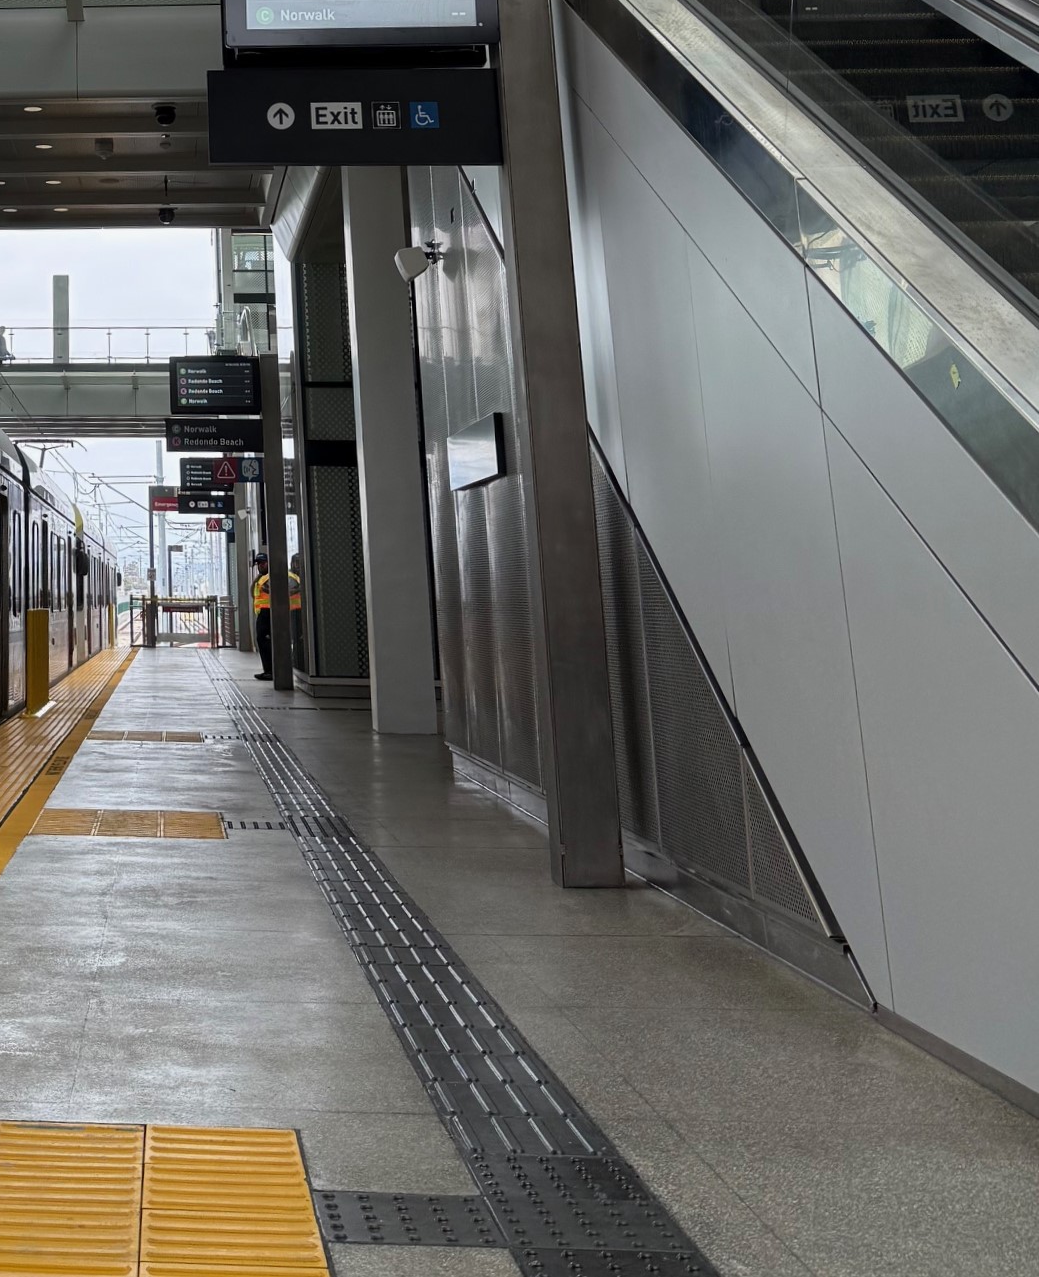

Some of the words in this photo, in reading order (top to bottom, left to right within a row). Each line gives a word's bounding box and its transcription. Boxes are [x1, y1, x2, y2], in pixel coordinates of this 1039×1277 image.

[261, 10, 270, 21] C
[280, 8, 336, 21] Norwalk
[314, 106, 359, 126] Exit
[184, 425, 217, 433] Norwalk
[184, 437, 218, 446] Redondo
[220, 437, 244, 446] Beach
